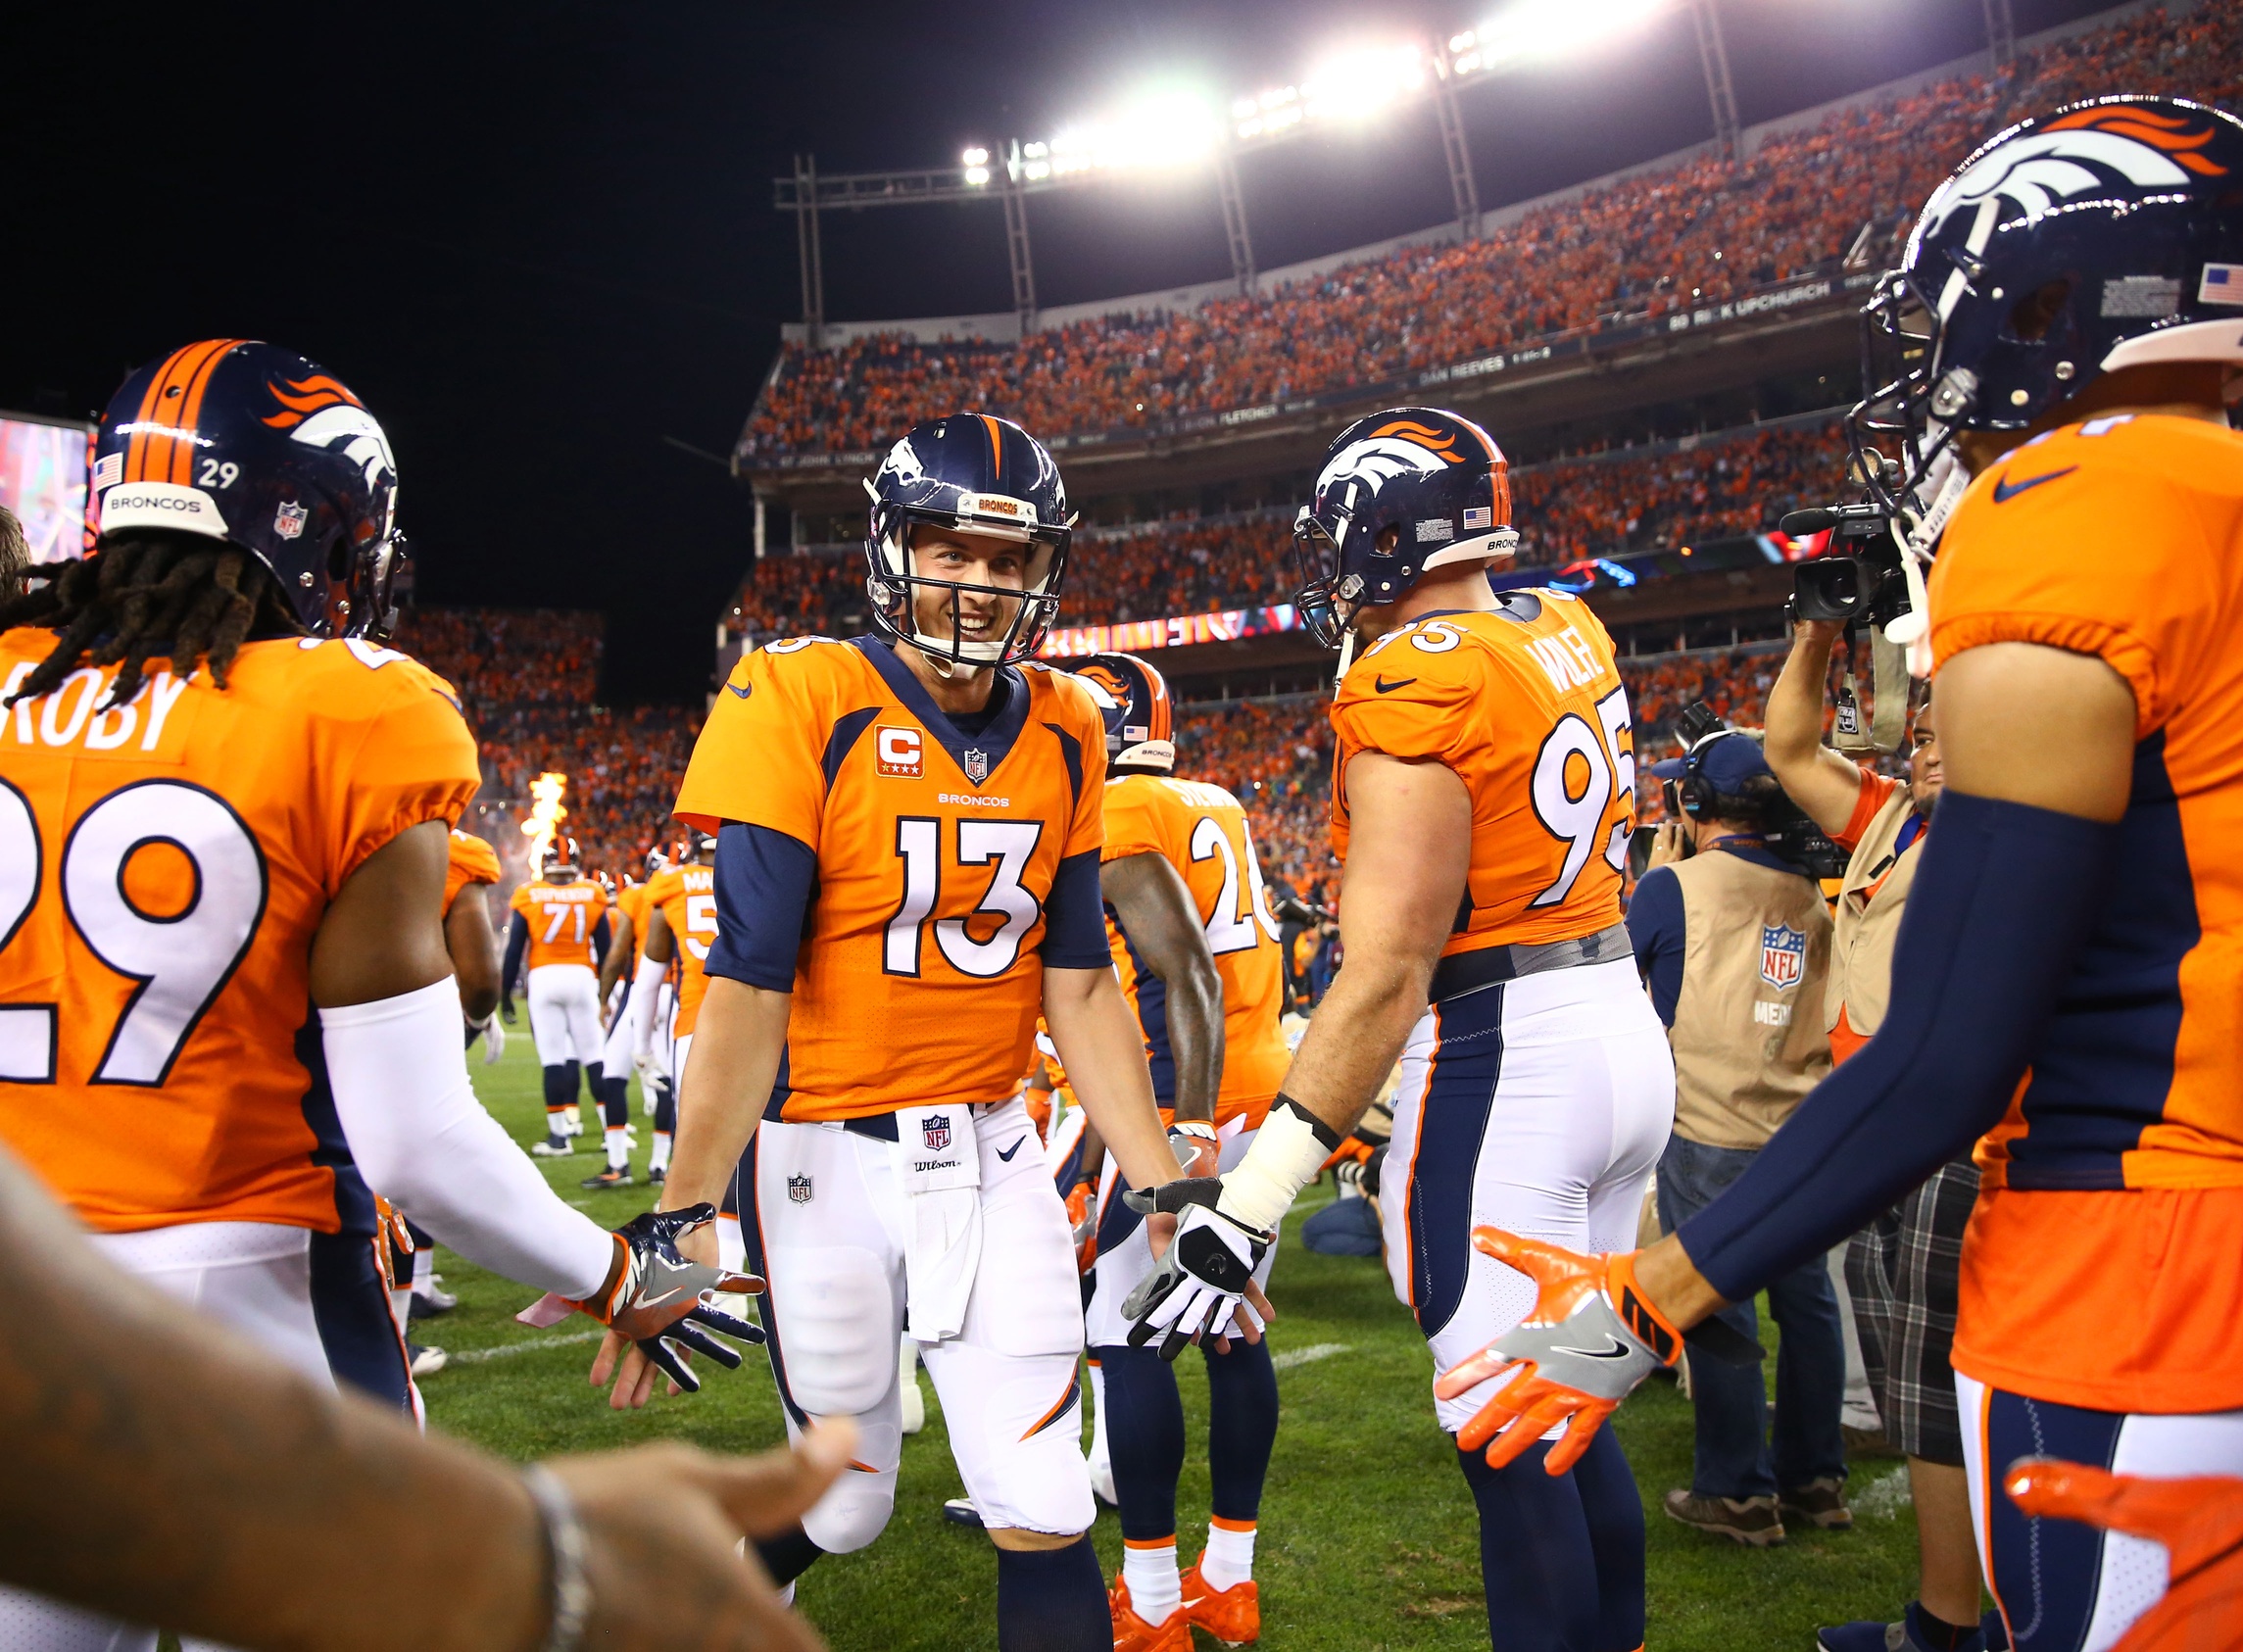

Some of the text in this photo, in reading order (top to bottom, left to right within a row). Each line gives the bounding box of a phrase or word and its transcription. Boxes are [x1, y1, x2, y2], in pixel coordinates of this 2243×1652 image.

[1694, 304, 1732, 325] RIK
[1736, 281, 1830, 316] UPCHURCH
[1450, 355, 1505, 378] REEVES
[1220, 406, 1279, 424] FLETCHER
[198, 458, 240, 489] 29
[111, 496, 201, 512] BRONCOS
[978, 499, 1018, 516] BRONCOS
[278, 517, 300, 535] NFL
[1524, 624, 1605, 695] WOLFE
[879, 728, 921, 765] C
[1142, 749, 1173, 758] BRONCOS
[968, 761, 985, 777] NFL
[938, 793, 1010, 807] BRONCOS
[1525, 681, 1636, 910] 95
[683, 870, 714, 893] MA
[882, 815, 1045, 979] 13
[542, 902, 587, 945] 71
[1763, 948, 1798, 982] NFL
[926, 1126, 949, 1149] NFL
[914, 1159, 956, 1173] Wilson
[792, 1186, 810, 1200] NFL
